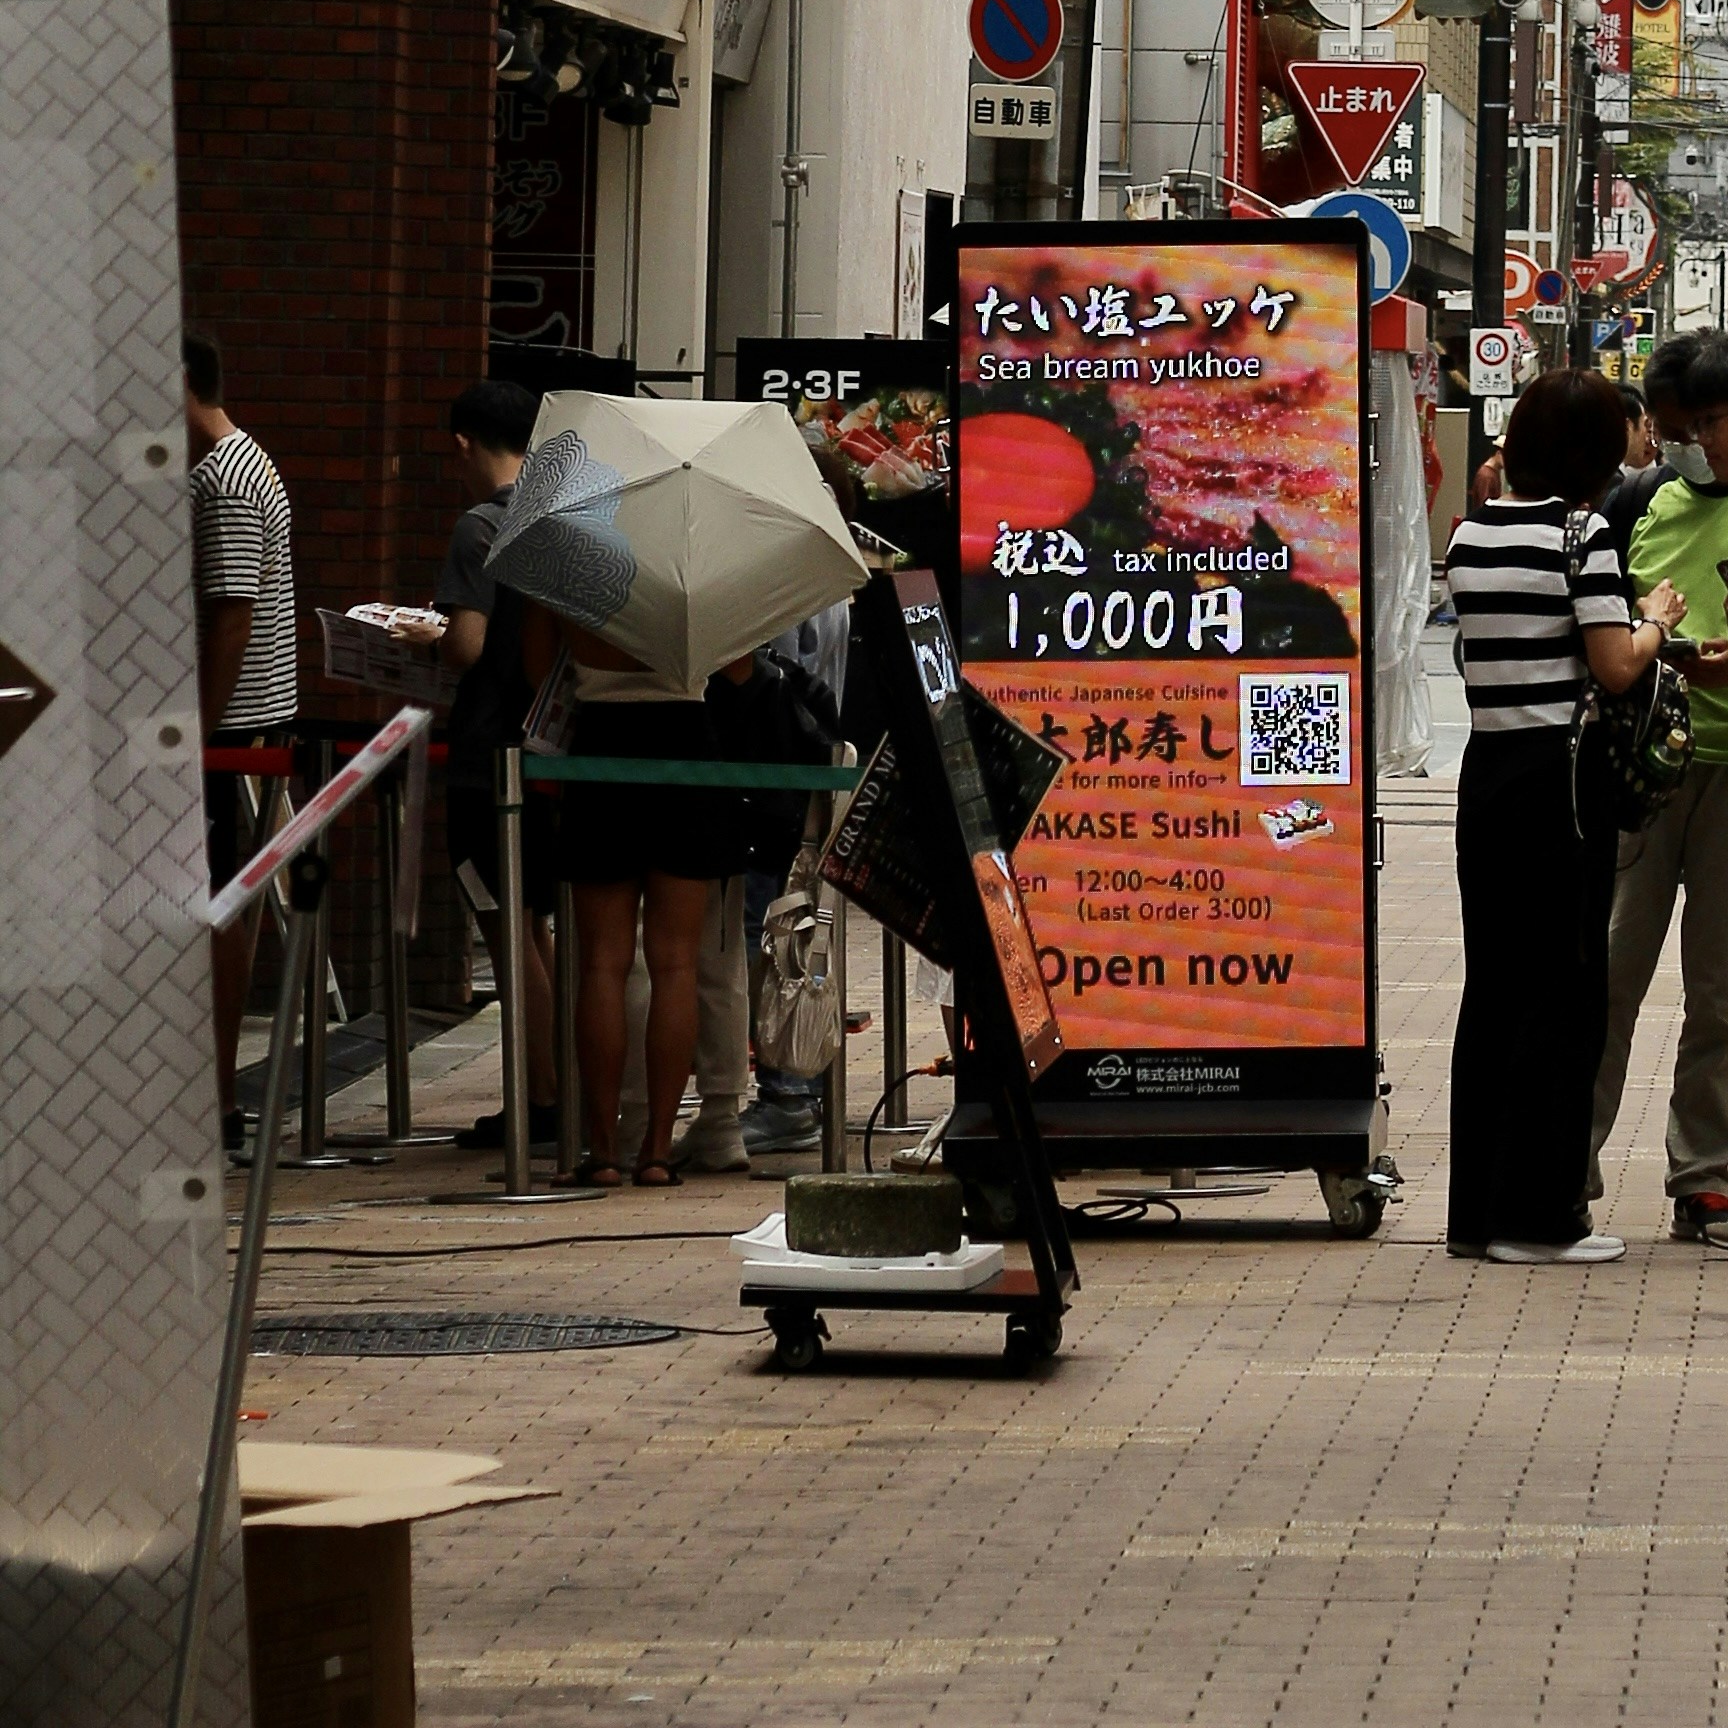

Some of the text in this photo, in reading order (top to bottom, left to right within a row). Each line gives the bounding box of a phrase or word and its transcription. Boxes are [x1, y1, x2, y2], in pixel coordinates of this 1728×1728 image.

[974, 98, 1052, 128] 自動車
[1315, 85, 1397, 113] 止まれ
[975, 285, 1296, 337] たい塩ユッケ
[1484, 342, 1502, 358] 30
[979, 352, 1261, 385] Sea bream yukhoe
[992, 520, 1089, 577] 税込
[1112, 544, 1289, 573] tax included
[1007, 585, 1244, 657] 1,000円
[979, 684, 1229, 705] uthentic Japanese Cuisine
[1071, 770, 1103, 789] for
[1106, 774, 1162, 789] more
[834, 781, 881, 858] GRAND
[1026, 809, 1241, 840] AKASE Sushi
[1018, 872, 1048, 895] en
[1077, 896, 1272, 924] (Last Order 3:00)
[1043, 945, 1295, 997] Open now
[1086, 1066, 1132, 1077] MIRAI
[1135, 1066, 1241, 1083] 株式会社MIRAI
